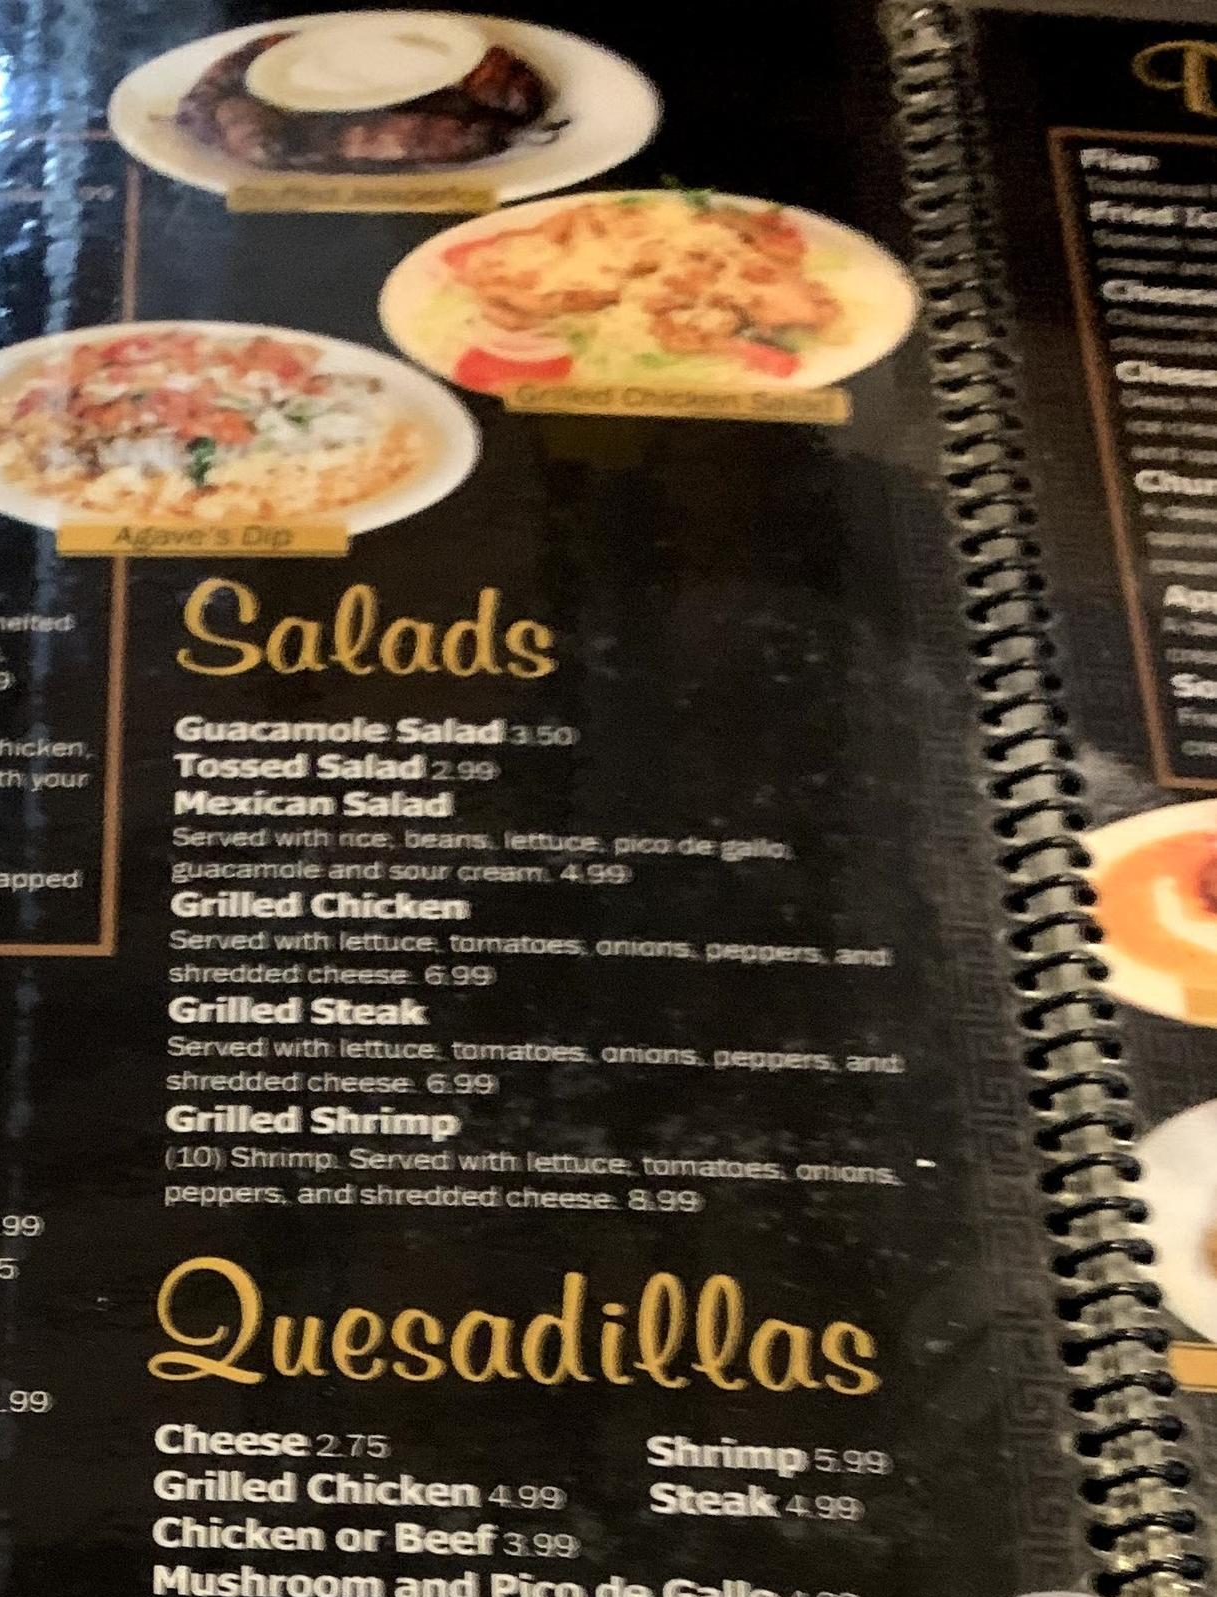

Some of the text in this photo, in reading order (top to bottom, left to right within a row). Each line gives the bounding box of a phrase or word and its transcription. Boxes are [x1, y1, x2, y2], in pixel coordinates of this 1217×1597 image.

[114, 526, 294, 550] Agave's Dip
[177, 577, 555, 678] Salads
[175, 716, 389, 743] Guacamole
[397, 718, 506, 744] Salad
[175, 790, 452, 817] Mexican Salad
[171, 891, 470, 920] Grilled Chicken
[169, 996, 428, 1025] Grilled Steak
[166, 1105, 461, 1142] Grilled Shrimp
[148, 1257, 879, 1395] Quesadillas
[647, 1436, 887, 1478] Shrimp 5.99
